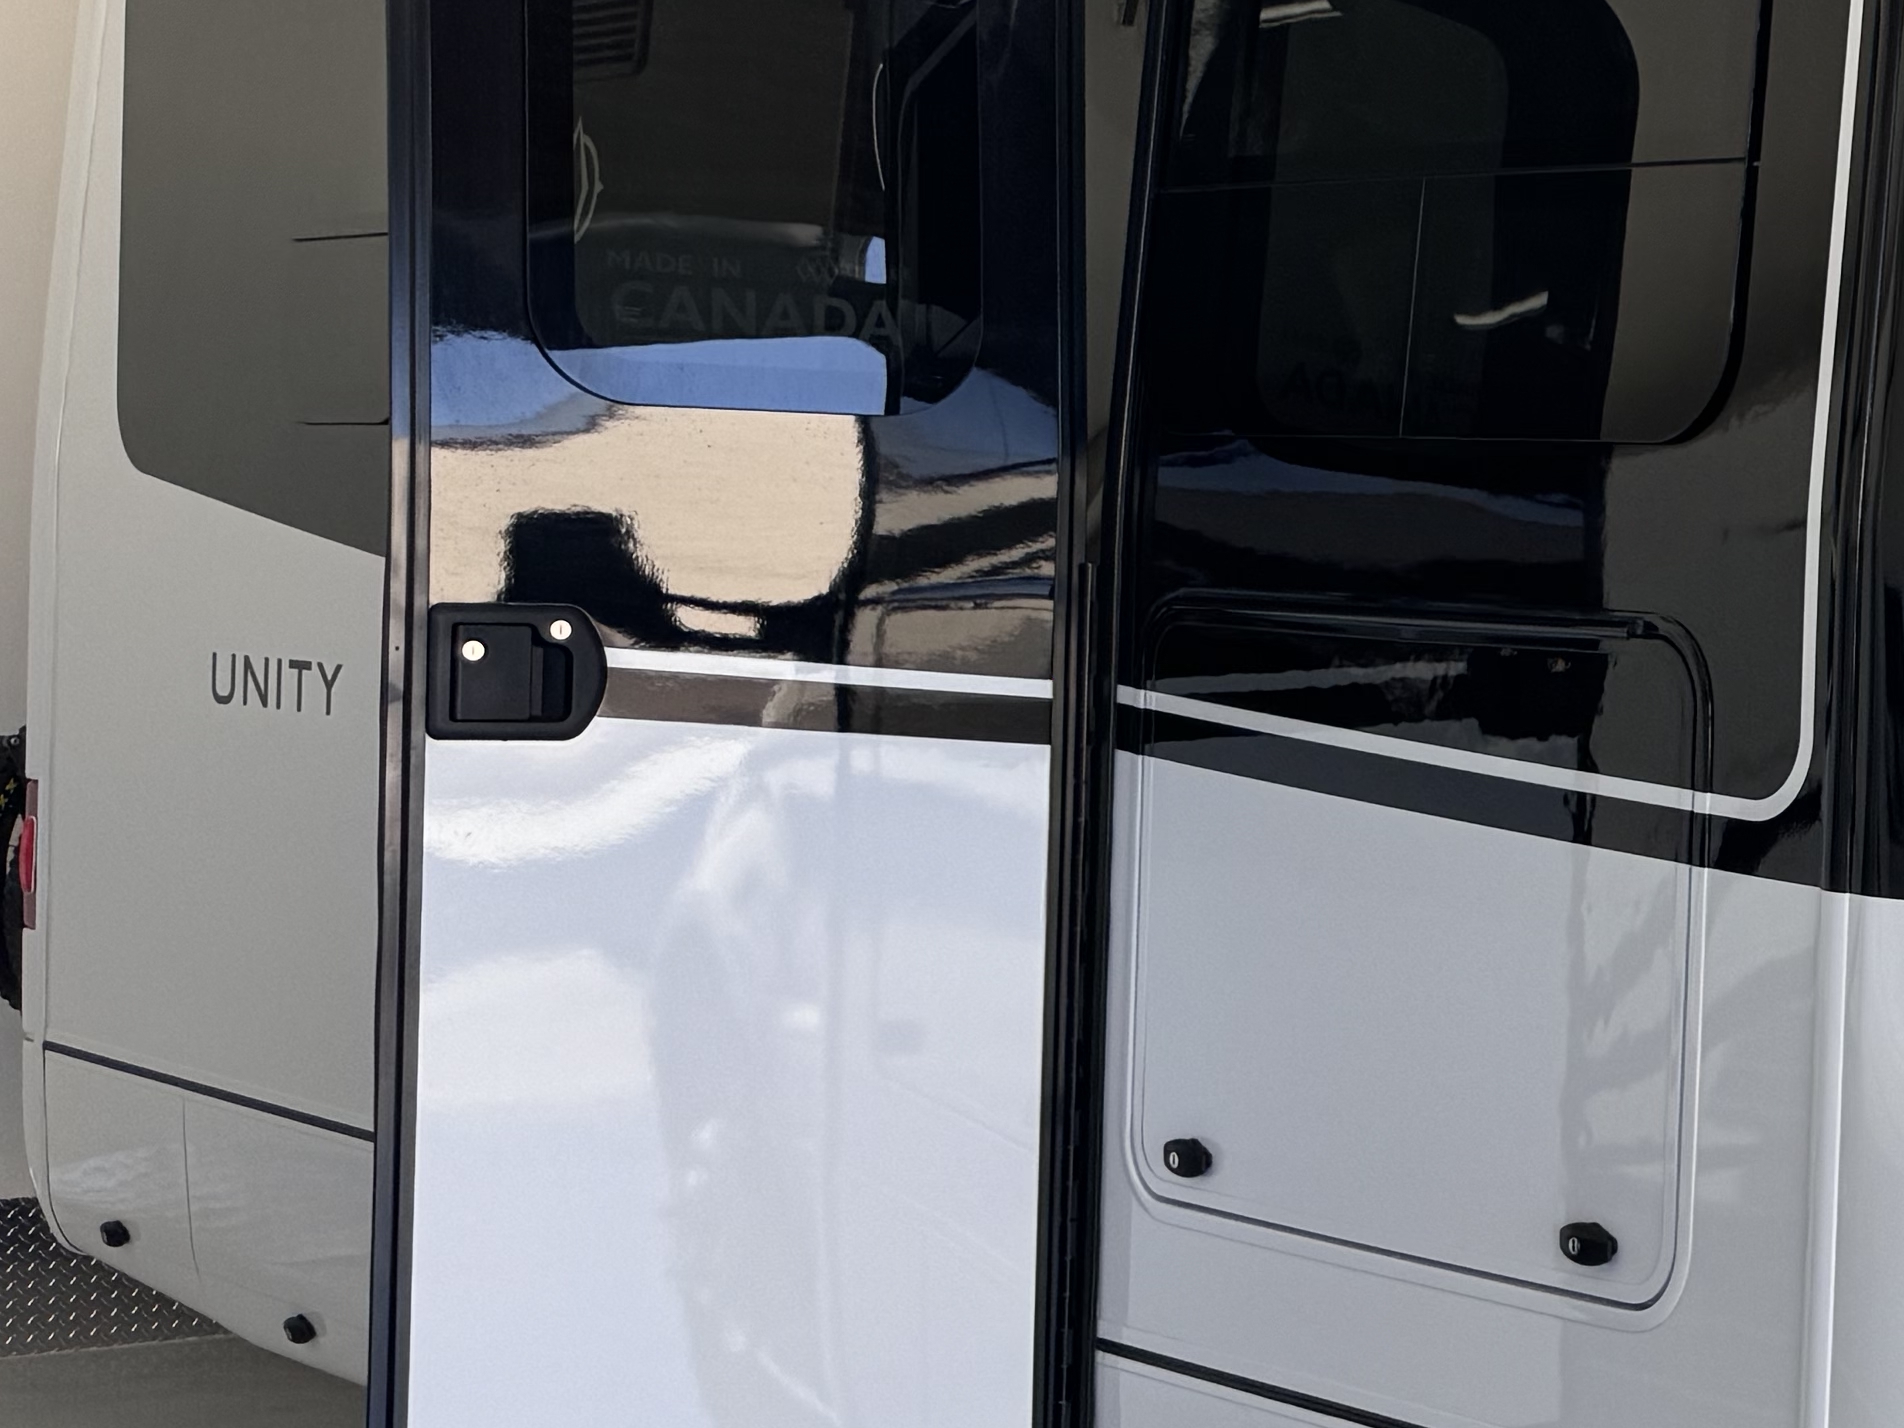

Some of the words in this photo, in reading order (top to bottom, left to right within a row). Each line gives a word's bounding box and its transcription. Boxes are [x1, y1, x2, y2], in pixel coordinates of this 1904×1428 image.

[605, 249, 693, 276] MADE
[610, 280, 902, 347] CANADA
[211, 651, 344, 716] UNITY
